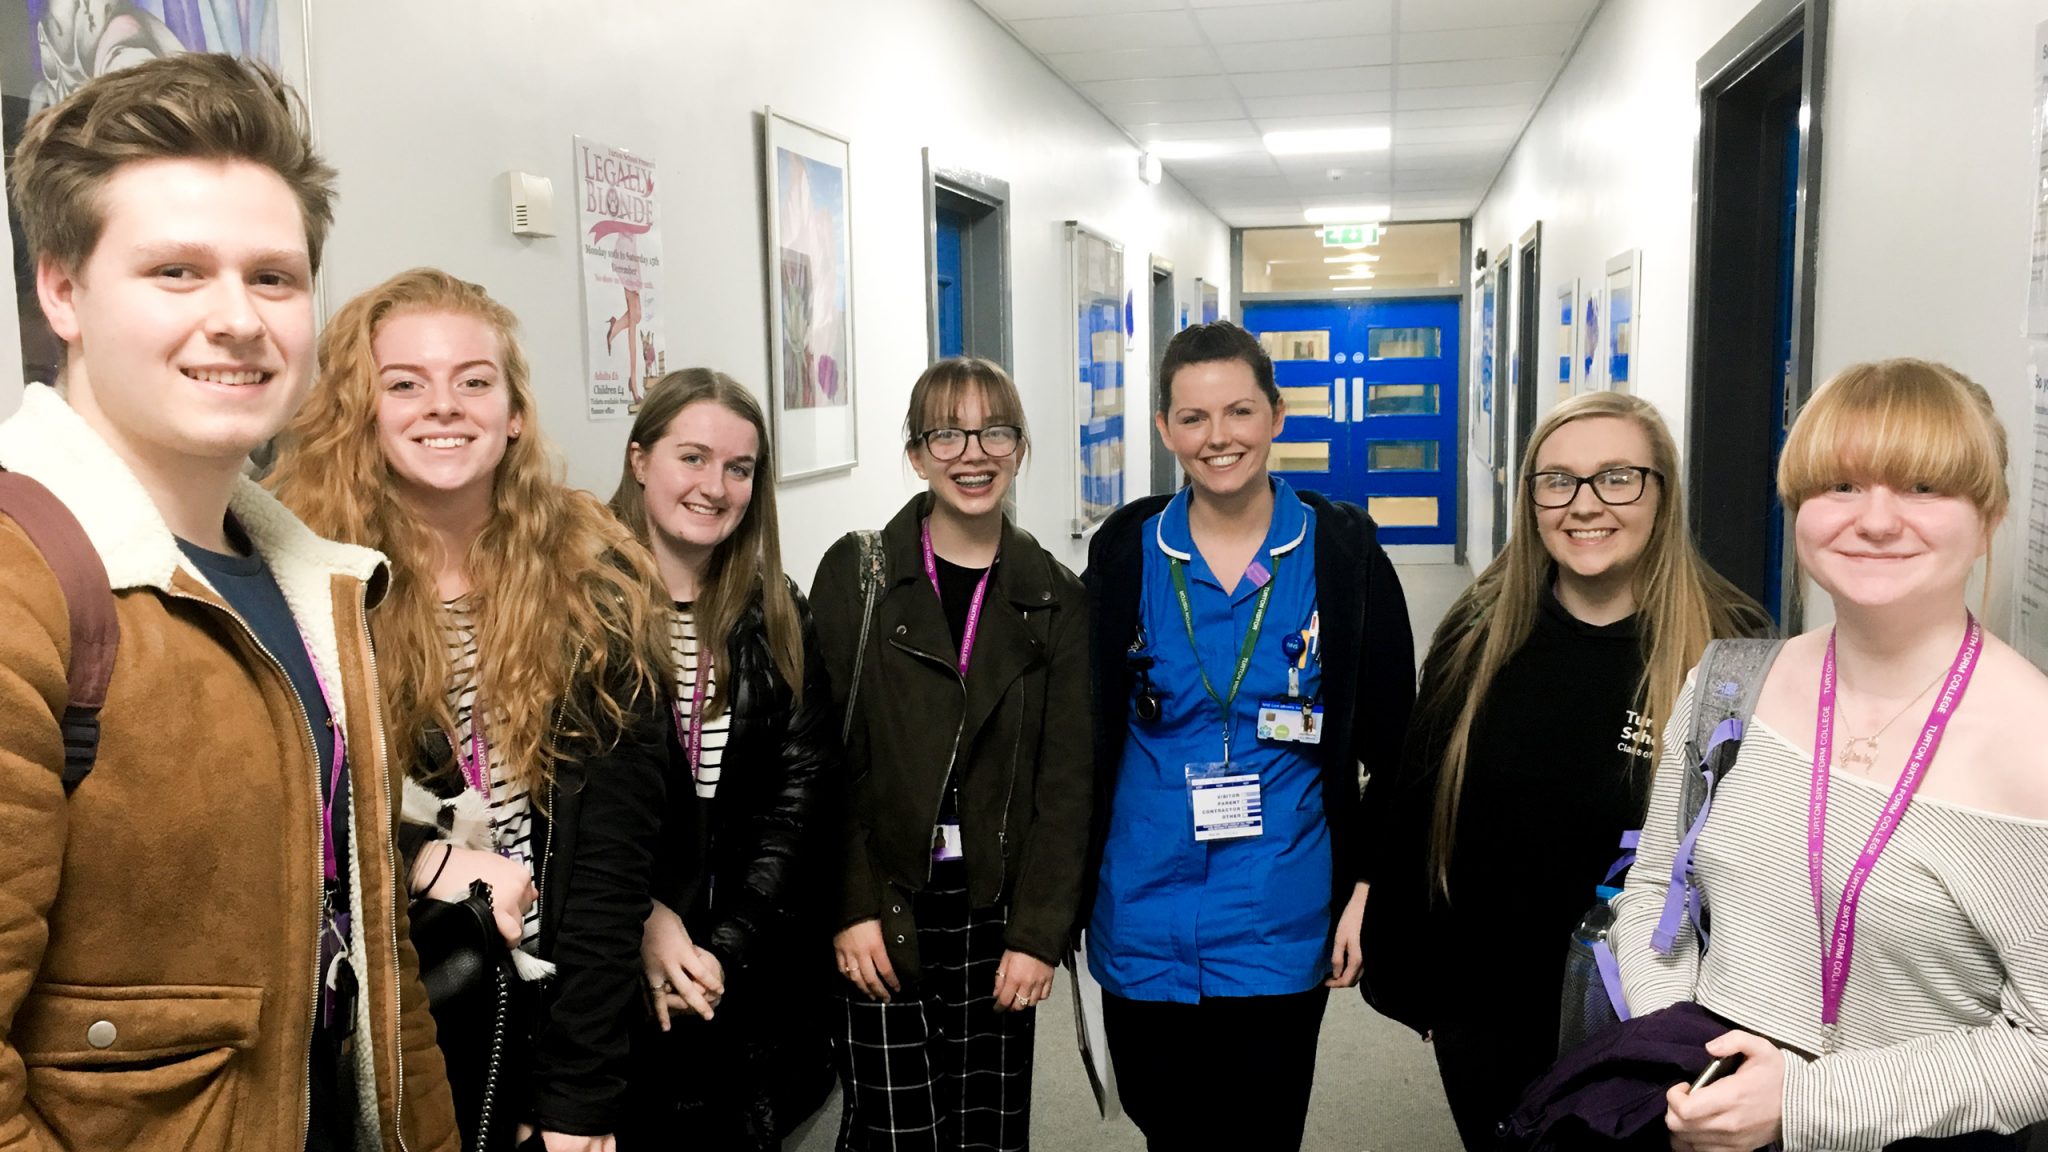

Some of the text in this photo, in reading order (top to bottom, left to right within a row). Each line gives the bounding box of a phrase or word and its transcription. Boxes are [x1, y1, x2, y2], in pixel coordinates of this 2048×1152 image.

[582, 146, 654, 198] LEGALLY
[585, 179, 653, 226] BLONDE
[585, 244, 607, 259] Monday
[594, 384, 617, 395] Children
[1252, 586, 1270, 631] TURTON VISITOR
[1957, 647, 1975, 674] FORM
[1823, 660, 1833, 695] TURTON
[1937, 674, 1963, 715] COLLEGE
[1625, 710, 1653, 728] Tur
[1617, 742, 1642, 757] Clas
[1620, 726, 1655, 746] Sch
[1812, 706, 1831, 839] TURTON SIXTH FORM COLLEGE
[1866, 724, 1939, 856] TURTON SIXTH FORM COLLEGE
[1202, 807, 1241, 815] CONTRACTOR
[1844, 867, 1865, 904] TURTON
[1839, 904, 1851, 932] SIXTH
[1835, 931, 1848, 960] FORM
